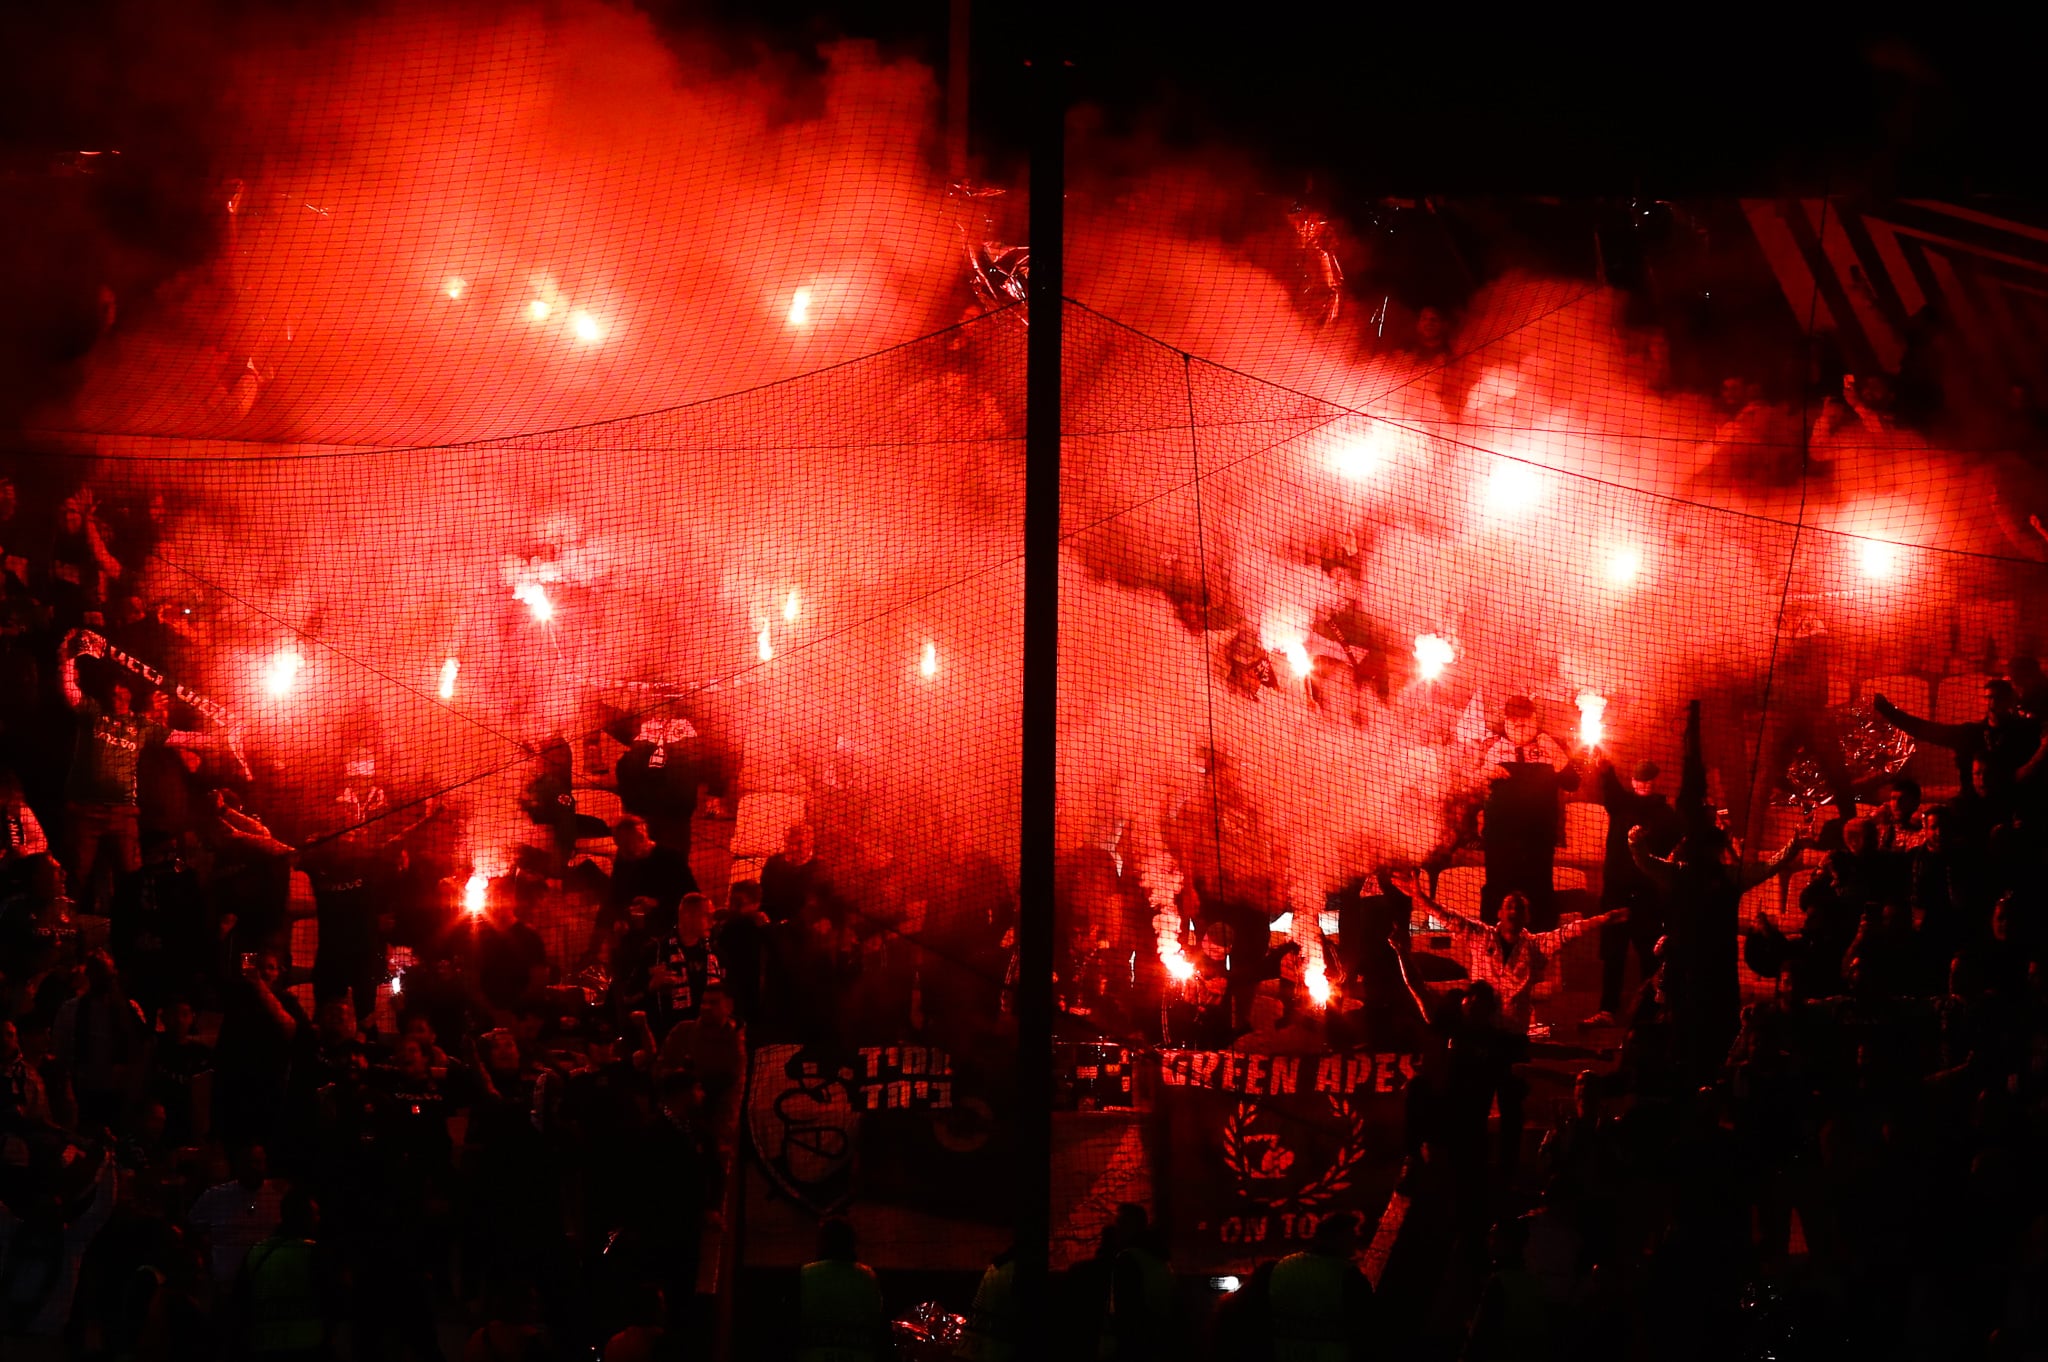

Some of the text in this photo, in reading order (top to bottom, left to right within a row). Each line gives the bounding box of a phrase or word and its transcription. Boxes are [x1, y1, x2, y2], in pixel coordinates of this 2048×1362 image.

[1161, 1049, 1424, 1096] GREEN APES
[1220, 1210, 1366, 1243] ON TO
